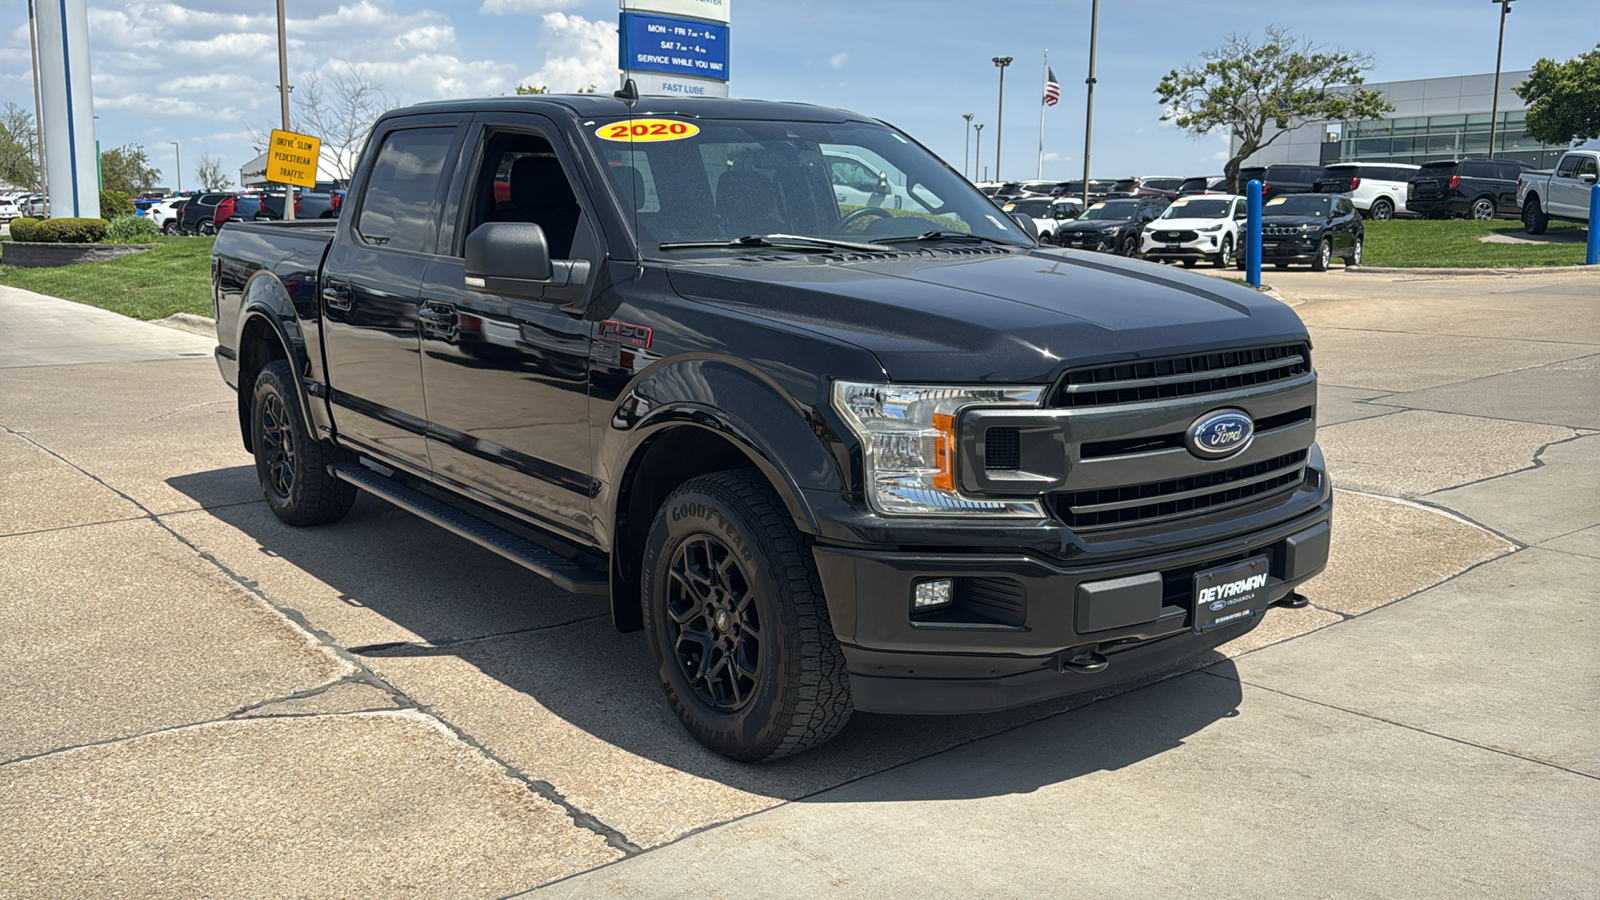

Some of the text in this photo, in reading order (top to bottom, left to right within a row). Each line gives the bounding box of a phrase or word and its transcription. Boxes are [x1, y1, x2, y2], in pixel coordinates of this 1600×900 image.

[648, 24, 666, 34] MON
[674, 27, 686, 36] FRI
[660, 41, 674, 50] SAT
[637, 54, 723, 71] SERVICE WHILE YOU WAIT
[662, 82, 705, 95] FAST LUBE
[610, 123, 687, 138] 2020
[276, 137, 313, 151] DRIVE SLOW
[274, 151, 311, 166] PEDESTRIAN
[279, 167, 304, 179] TRAFFIC
[1210, 422, 1243, 445] Ford
[672, 502, 753, 562] GOODYEAR
[1198, 573, 1267, 605] DEYARMAN
[1227, 592, 1255, 605] INDIANOLA
